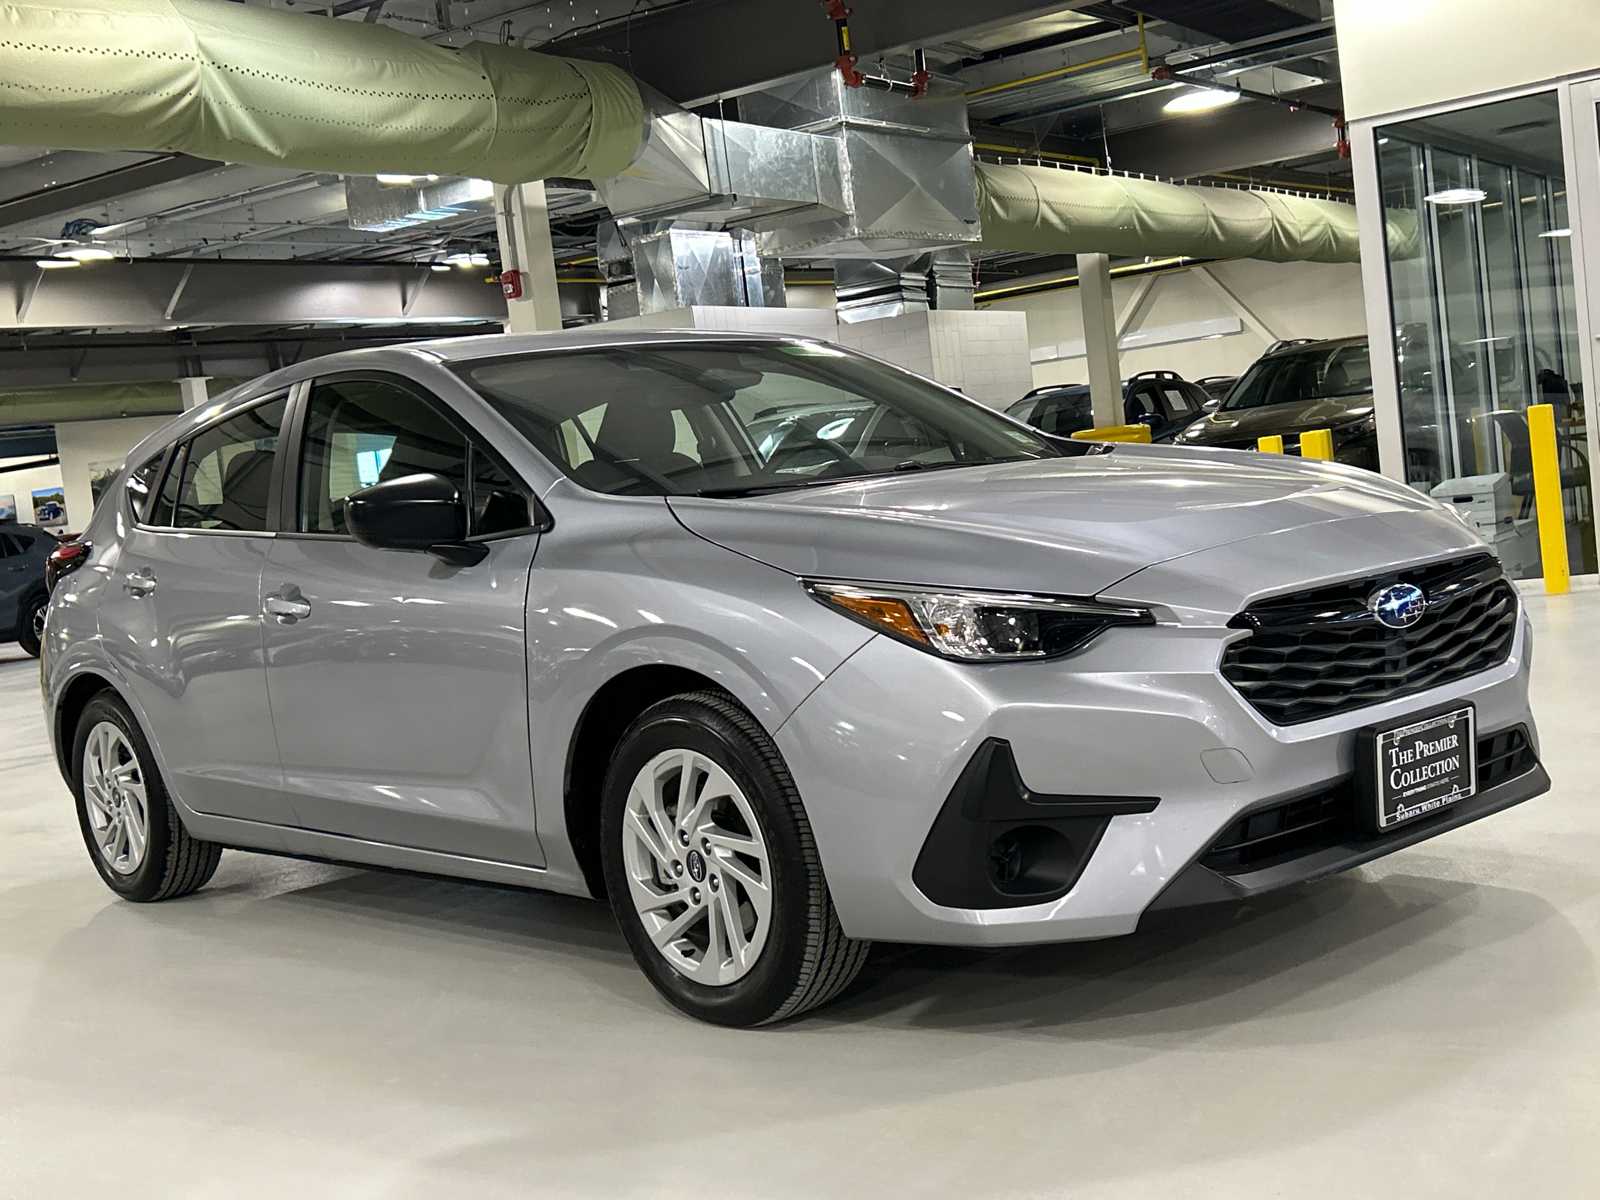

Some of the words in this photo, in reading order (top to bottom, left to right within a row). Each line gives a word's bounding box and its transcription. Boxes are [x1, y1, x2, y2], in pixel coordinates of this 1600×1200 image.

[1388, 747, 1414, 767] THE
[1414, 734, 1459, 760] PREMIER
[1390, 755, 1459, 790] COLLECTION
[1396, 807, 1421, 822] Subaru
[1421, 800, 1441, 812] White
[1441, 793, 1462, 806] Plains
